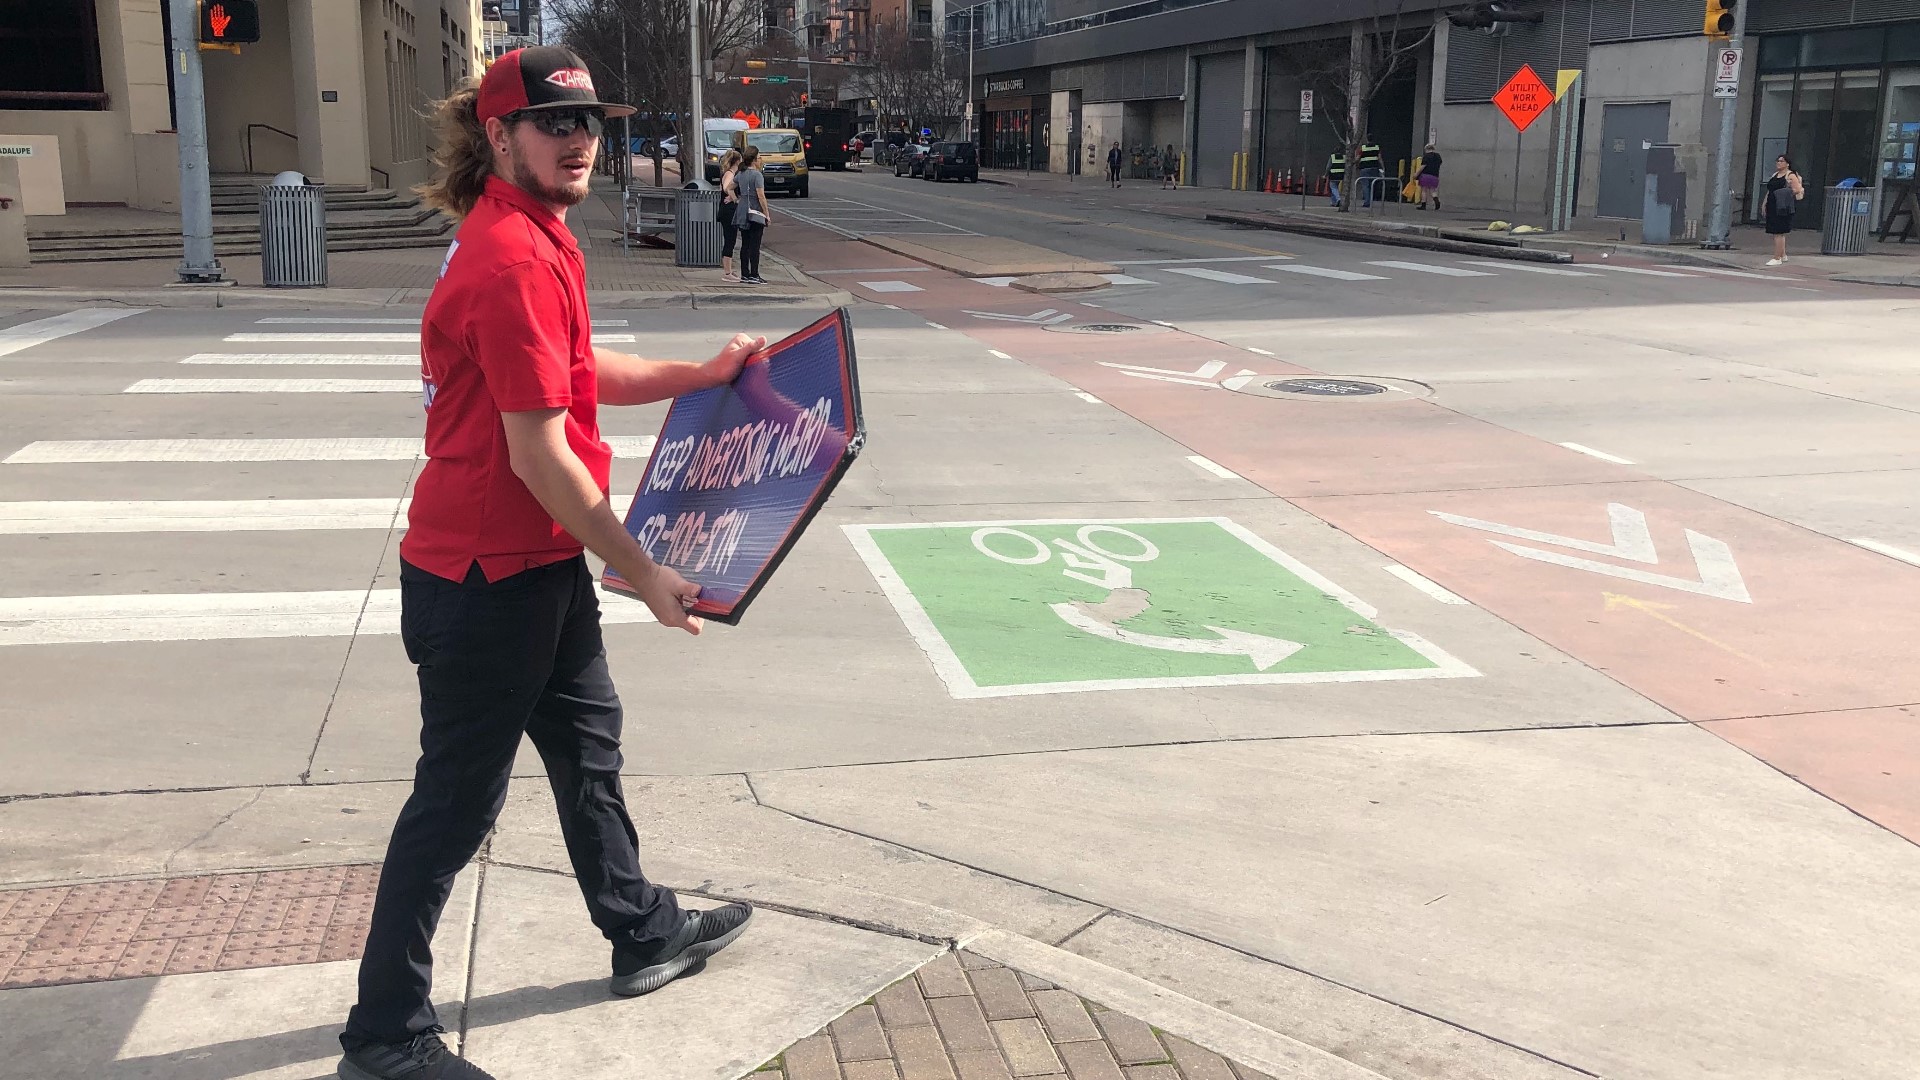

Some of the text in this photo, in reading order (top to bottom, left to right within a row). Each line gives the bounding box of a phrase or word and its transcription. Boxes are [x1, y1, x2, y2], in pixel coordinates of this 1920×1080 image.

[1509, 83, 1541, 92] UTILITY
[1513, 93, 1536, 102] WORK
[1510, 103, 1539, 112] AHEAD
[644, 396, 832, 496] KEEP ADVERTISING WEIRD
